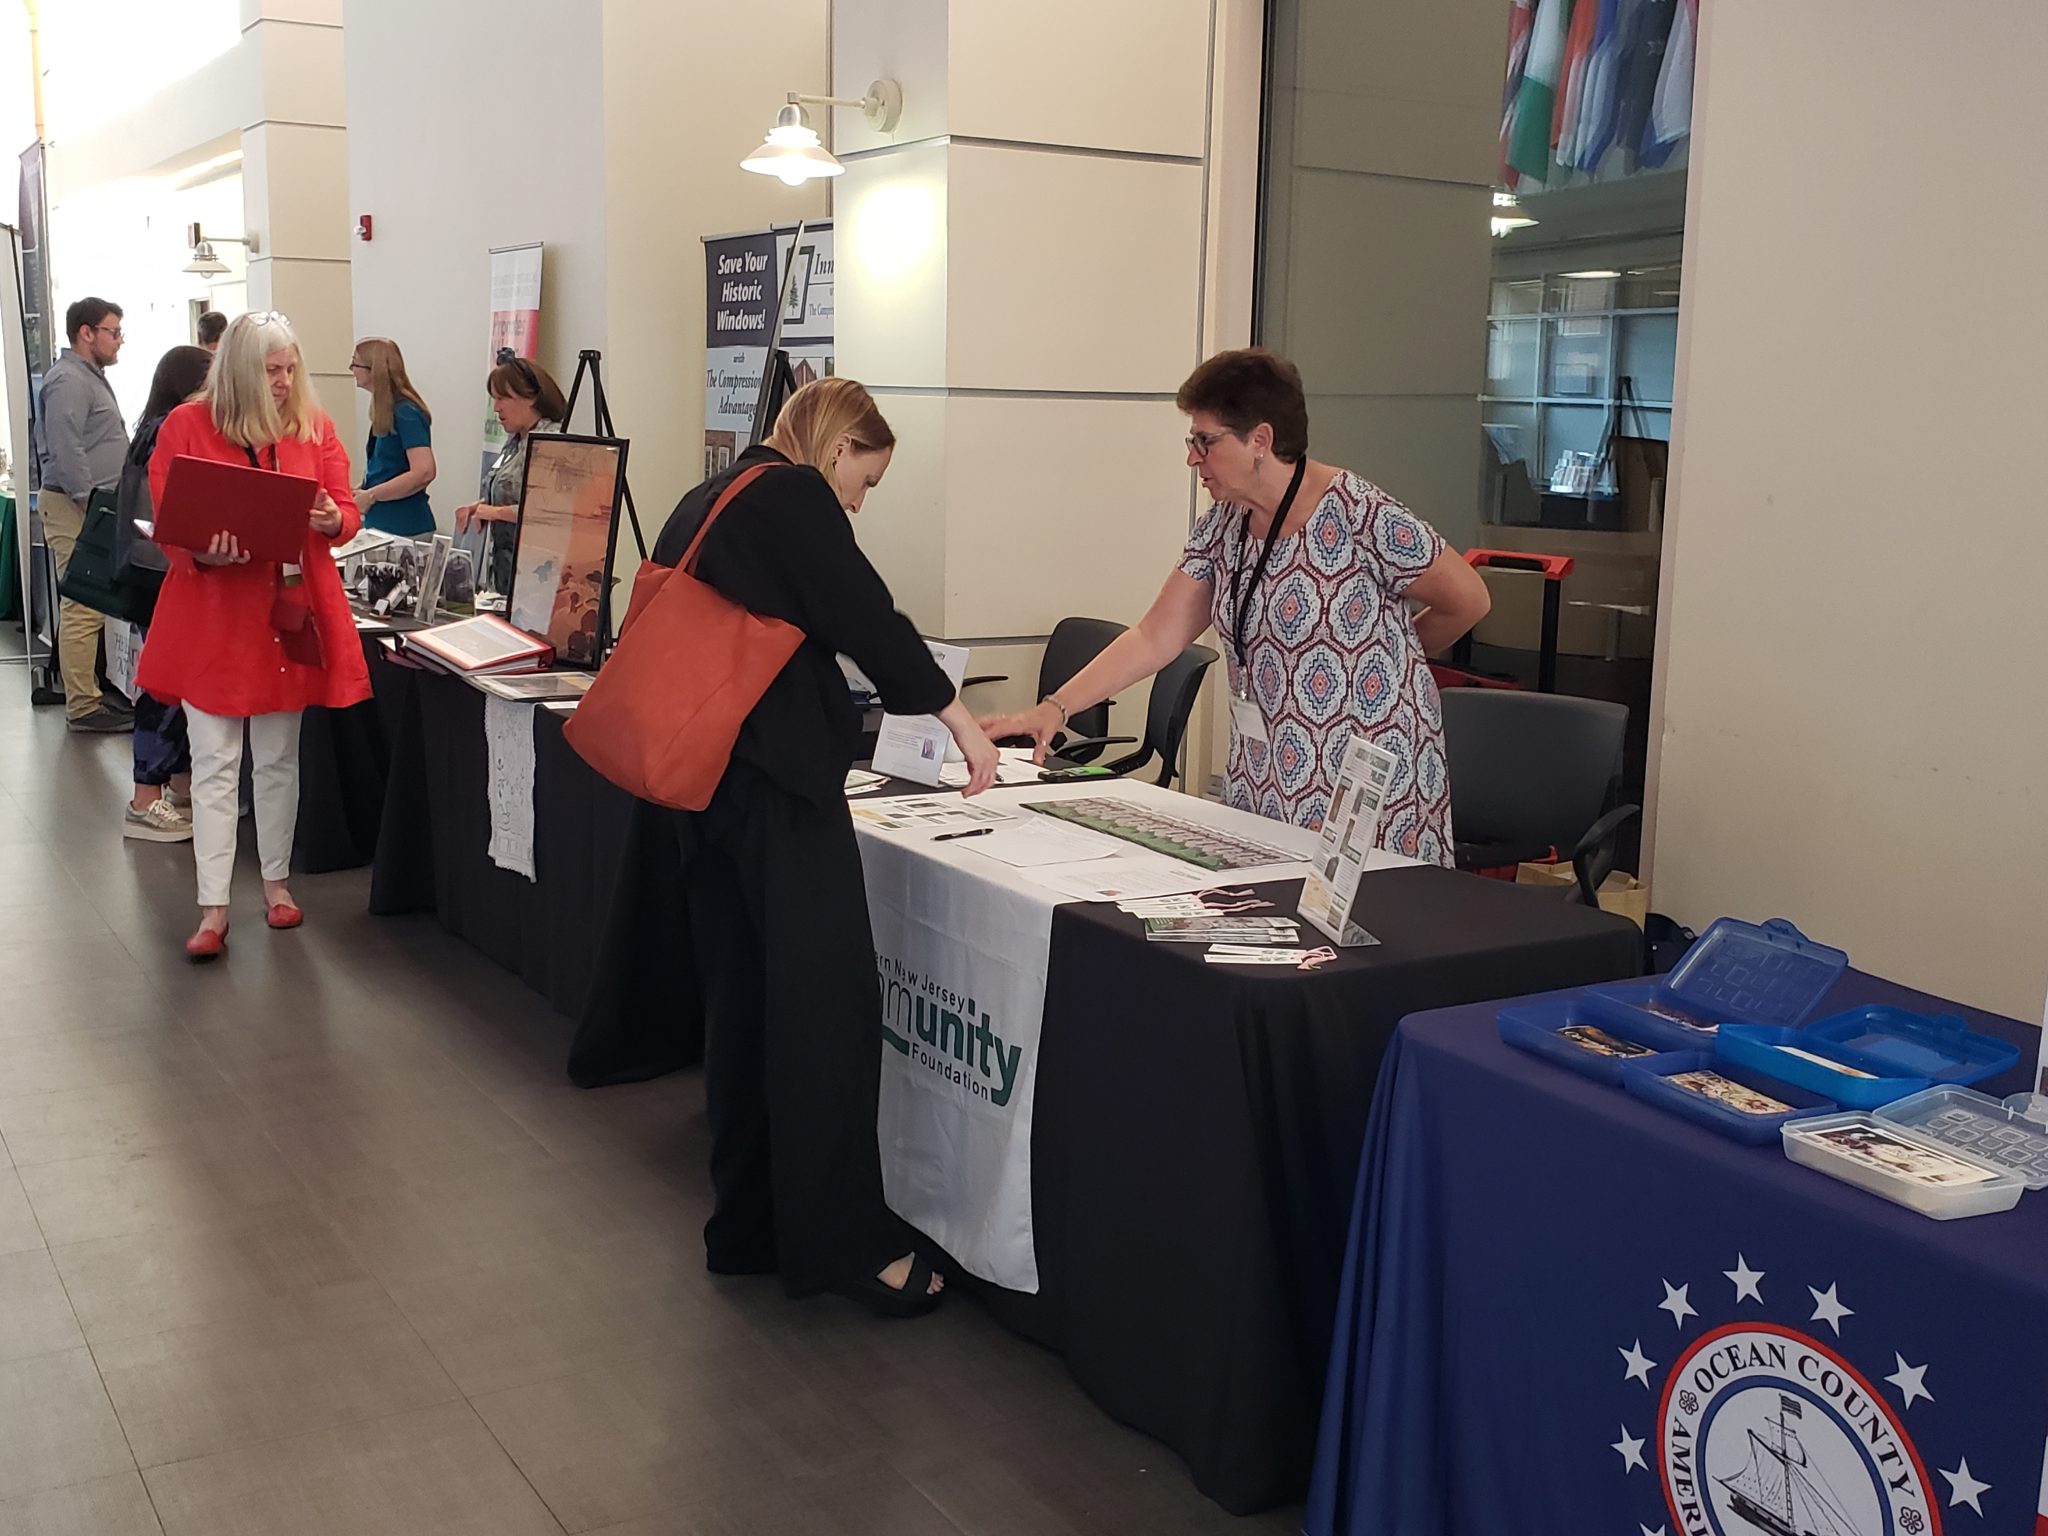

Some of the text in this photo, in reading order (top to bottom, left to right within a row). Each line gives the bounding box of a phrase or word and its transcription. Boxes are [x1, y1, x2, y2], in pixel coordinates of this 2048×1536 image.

[717, 251, 769, 275] Save Your
[721, 279, 763, 302] Historic
[716, 308, 766, 331] Windows!
[706, 369, 718, 388] The
[895, 958, 918, 986] New
[921, 974, 965, 1014] Jersey
[911, 1042, 988, 1100] Foundation
[1693, 1341, 1916, 1498] OCEAN COUNTY
